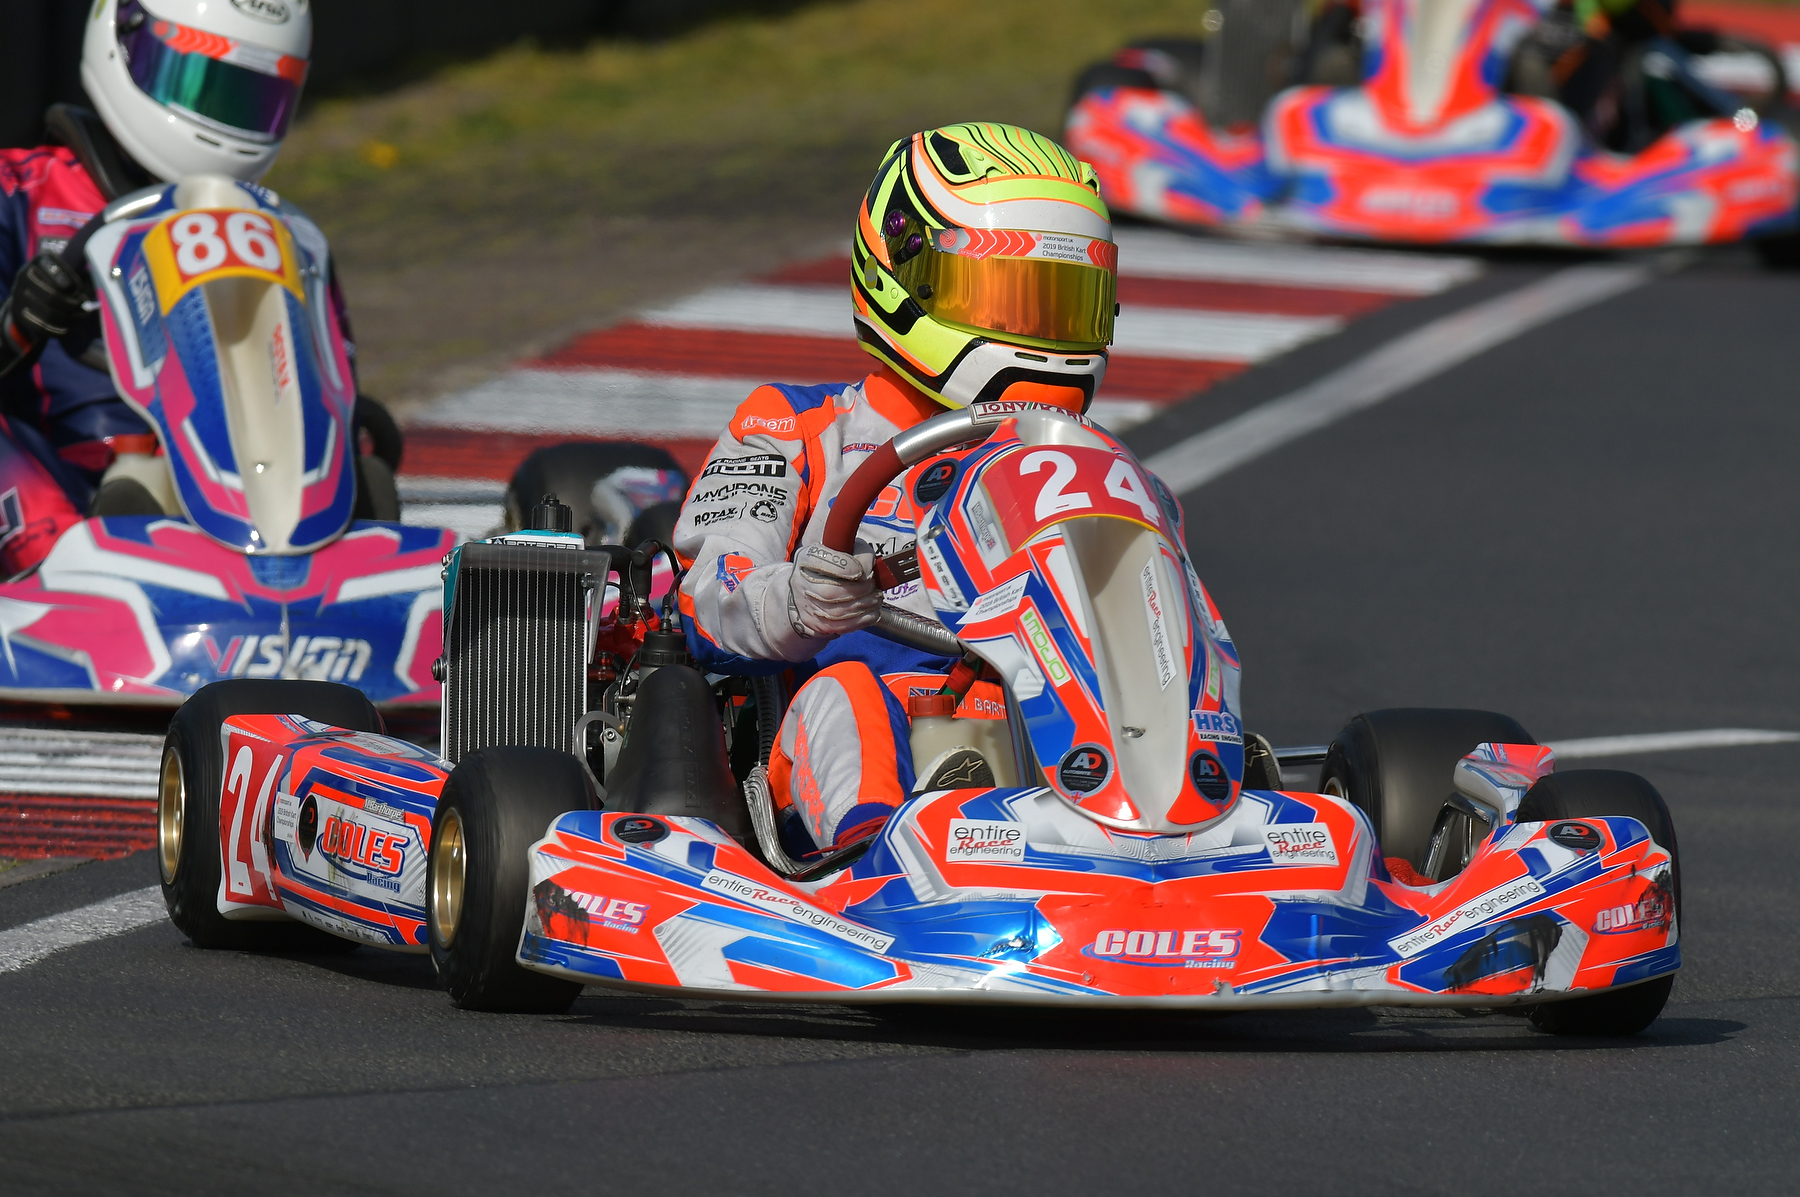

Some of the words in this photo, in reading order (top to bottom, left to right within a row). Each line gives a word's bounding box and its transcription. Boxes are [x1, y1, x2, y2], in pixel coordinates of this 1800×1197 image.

[171, 211, 282, 276] 86
[1058, 243, 1076, 252] British
[1076, 245, 1086, 254] Kart
[1042, 250, 1083, 261] Championships
[981, 402, 1026, 413] TONY
[1019, 450, 1161, 527] 24
[807, 546, 848, 567] sparco
[1194, 713, 1236, 734] HRS
[1200, 733, 1220, 741] RACING
[1071, 752, 1103, 769] AD
[1200, 759, 1220, 776] AD
[228, 745, 284, 901] 24
[955, 825, 1021, 841] entire
[1267, 828, 1327, 843] entire
[322, 816, 408, 874] COLES
[950, 846, 1022, 857] engineering
[956, 837, 1014, 850] Race
[1273, 840, 1326, 853] Race
[1272, 849, 1336, 861] engineering
[367, 870, 401, 893] Racing
[554, 887, 649, 925] OLES
[603, 919, 639, 934] Racing
[1094, 929, 1242, 957] COLES
[1184, 958, 1236, 969] Racing
